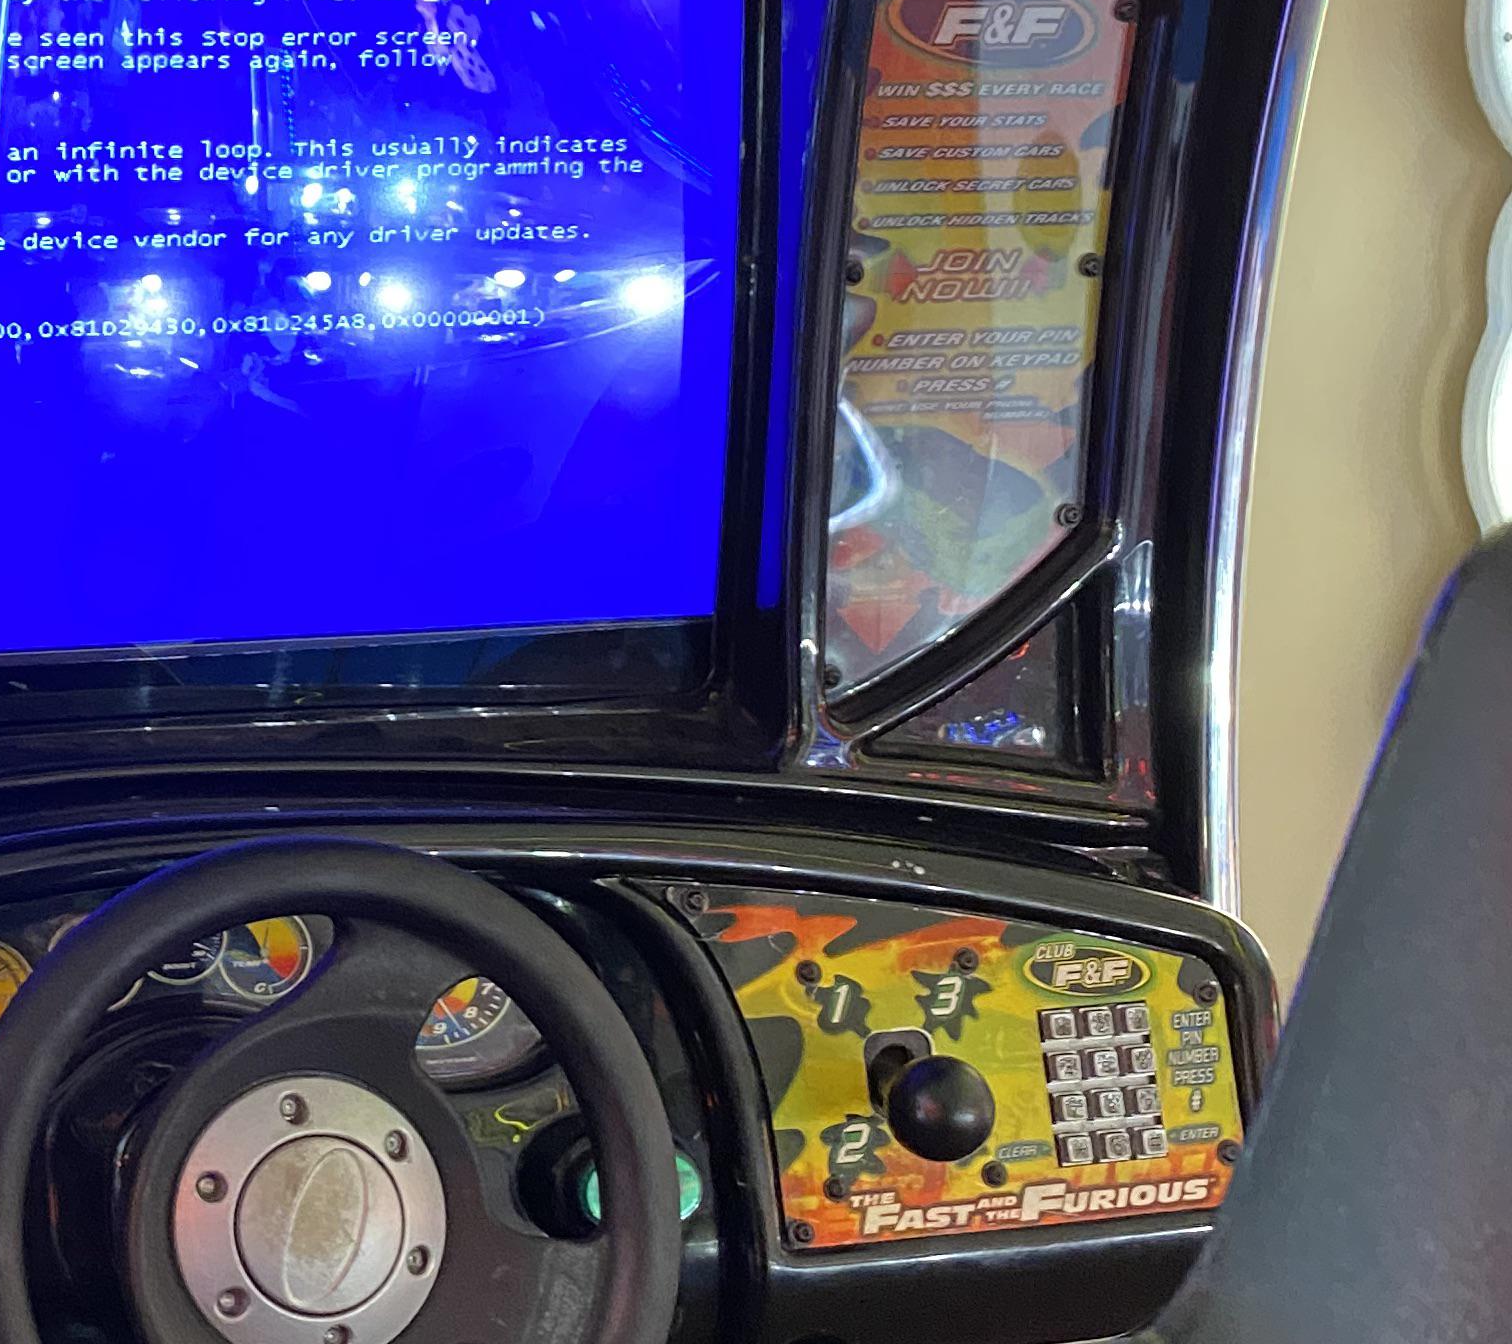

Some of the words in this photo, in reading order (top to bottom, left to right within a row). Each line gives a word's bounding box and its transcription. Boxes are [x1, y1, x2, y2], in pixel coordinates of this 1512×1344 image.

[933, 4, 1066, 46] F&F
[39, 31, 105, 47] seen
[121, 27, 183, 47] this
[202, 29, 264, 51] Stop
[282, 30, 357, 47] error
[877, 83, 921, 98] WIN
[979, 83, 1042, 97] EVERY
[1050, 82, 1105, 96] RACE
[6, 145, 39, 161] an
[56, 140, 184, 161] infinite
[200, 140, 272, 164] loop.
[294, 139, 354, 157] This
[372, 136, 479, 158] usually
[495, 136, 628, 154] indicates
[916, 250, 1019, 273] JOIN
[886, 332, 965, 348] ENTER
[967, 330, 1029, 345] YOUR
[1037, 328, 1079, 343] PIN
[848, 356, 945, 373] NUMBER
[950, 354, 986, 370] ON
[990, 352, 1080, 368] KEYPAD
[912, 378, 990, 393] PRESS
[1036, 944, 1074, 960] CLUB
[1054, 958, 1131, 988] F&F
[833, 981, 850, 1023] 1
[931, 976, 963, 1016] 3
[1174, 1069, 1214, 1085] PRESS
[837, 1123, 869, 1164] 2
[850, 1192, 896, 1208] THE
[976, 1195, 1018, 1208] AND
[1021, 1178, 1211, 1223] FURIOUS
[862, 1203, 976, 1234] FAST
[985, 1208, 1023, 1221] THE
